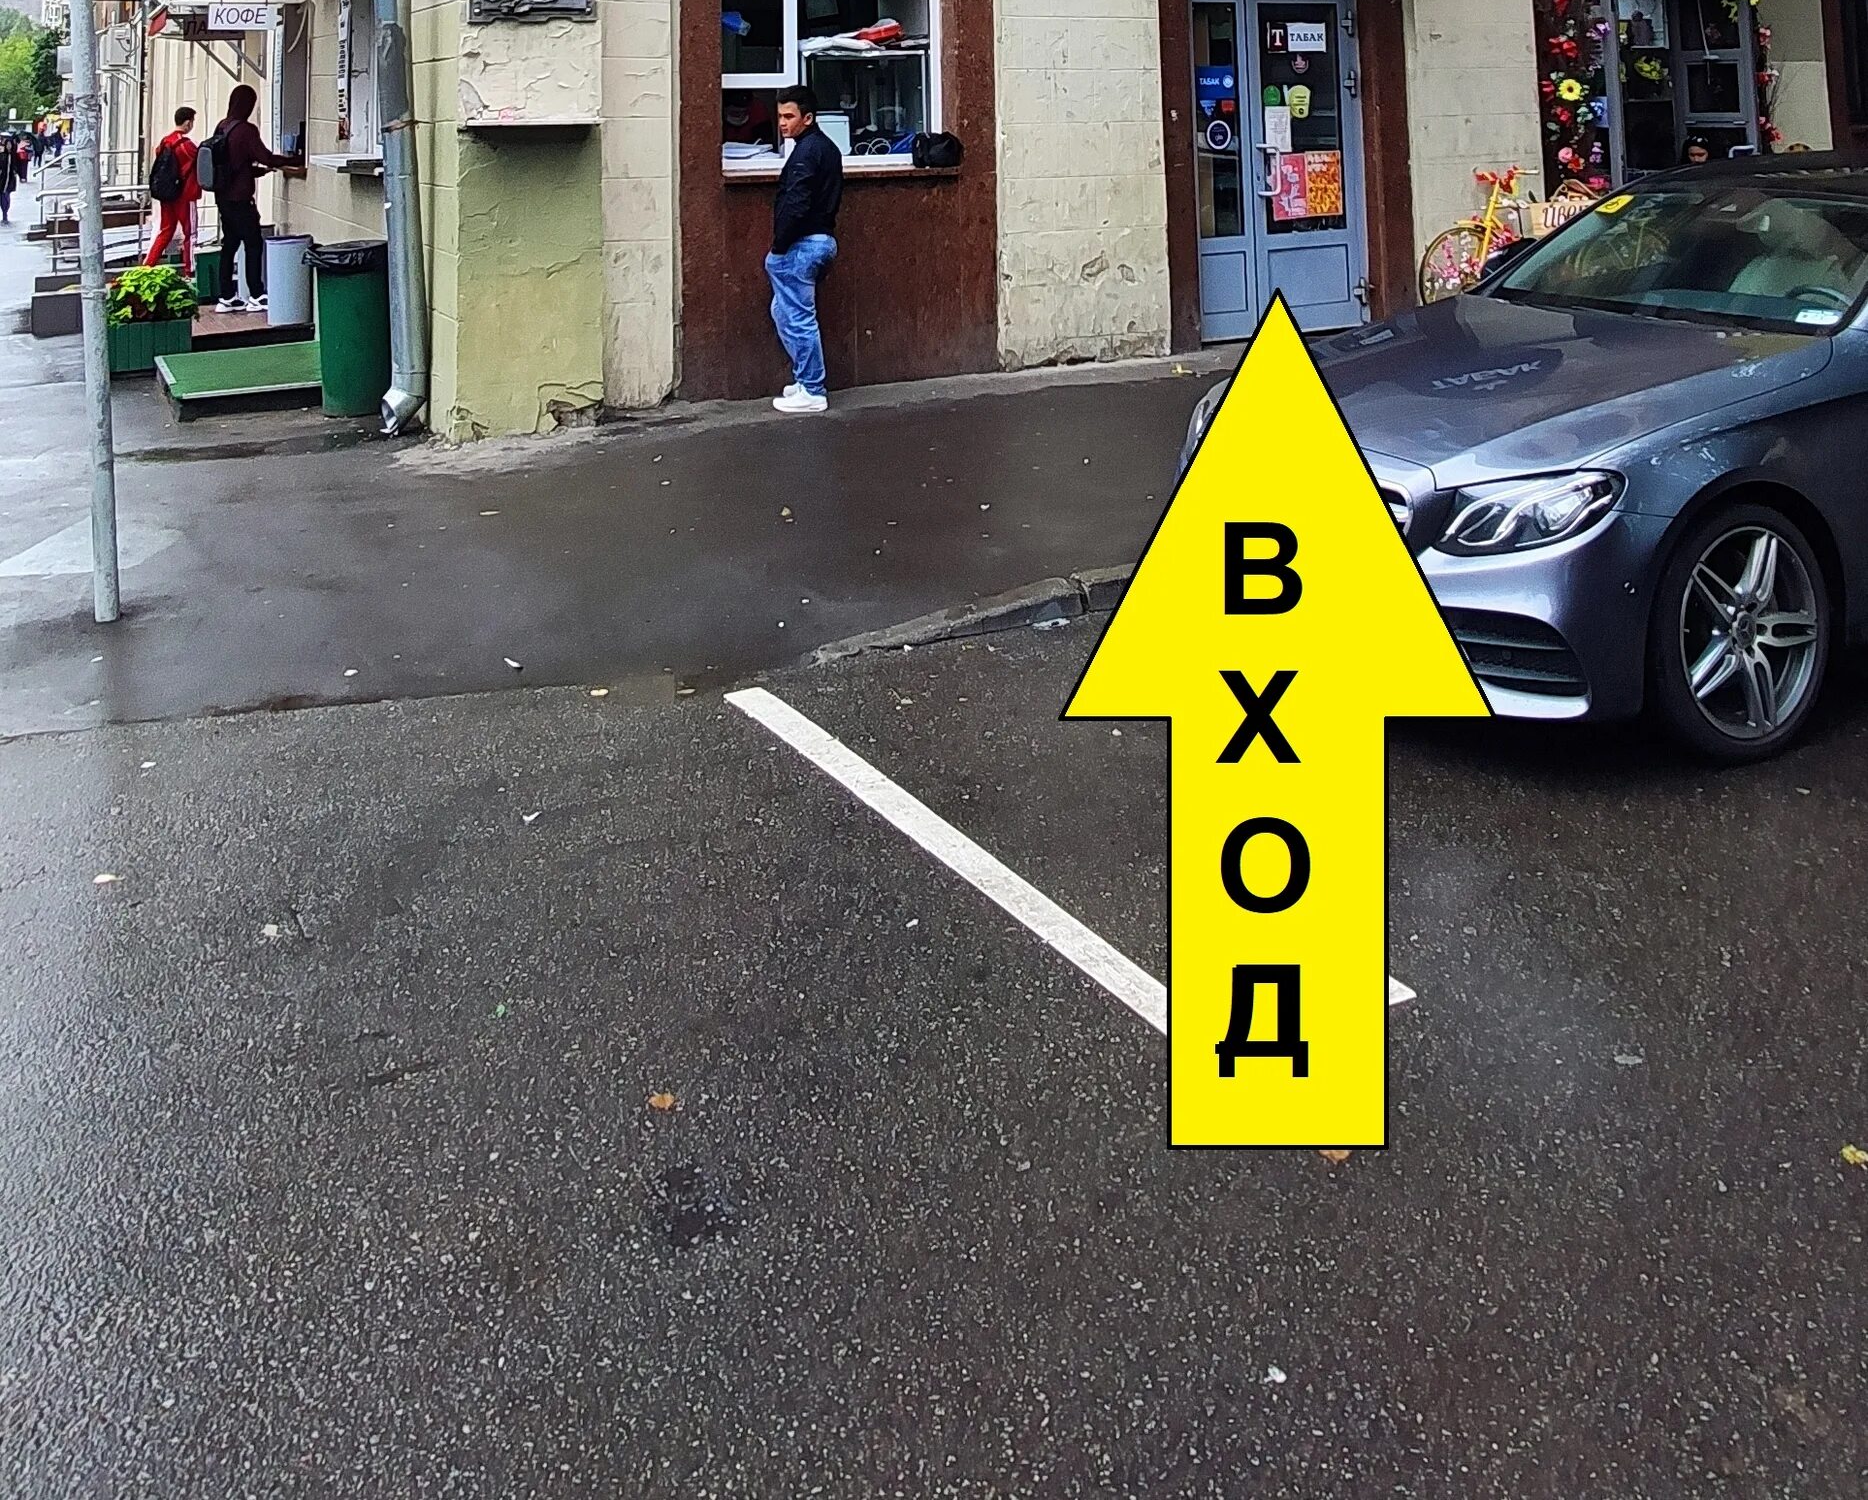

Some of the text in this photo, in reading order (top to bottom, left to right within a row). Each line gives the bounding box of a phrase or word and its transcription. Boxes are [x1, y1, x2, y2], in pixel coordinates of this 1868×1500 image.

[214, 7, 268, 25] КОФЕ
[1289, 33, 1324, 42] ТАБАК
[1199, 77, 1220, 86] ТАБАК
